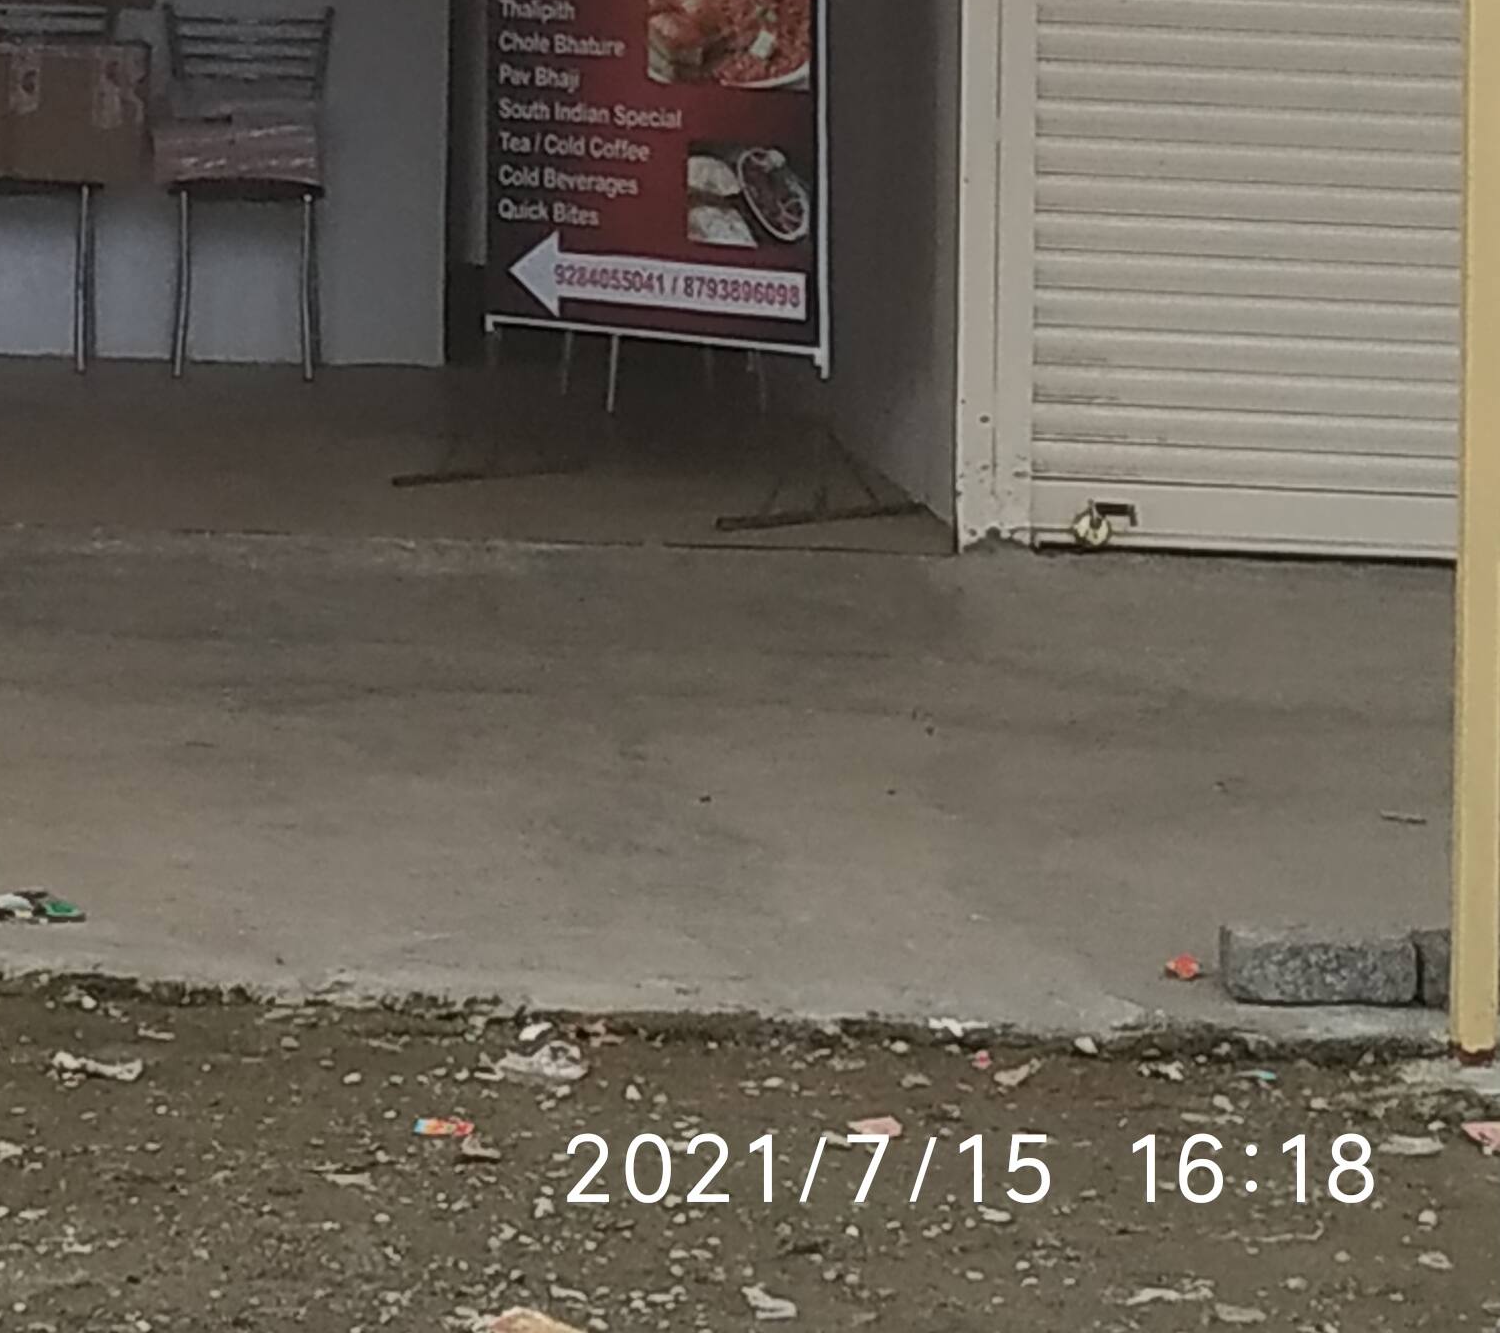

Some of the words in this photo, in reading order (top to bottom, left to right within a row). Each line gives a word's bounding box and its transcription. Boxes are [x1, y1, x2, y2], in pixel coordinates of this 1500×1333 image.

[499, 33, 550, 54] Chole
[554, 36, 626, 58] Bhature
[500, 66, 531, 86] Pav
[535, 68, 580, 93] Bhaji
[499, 99, 550, 121] South
[555, 102, 608, 124] Indian
[615, 105, 682, 130] Special
[500, 132, 531, 152] Tea
[544, 135, 584, 156] Cold
[590, 137, 650, 162] Coffee
[499, 165, 540, 188] Cold
[544, 167, 638, 197] Beverages
[498, 199, 548, 221] Quick
[553, 202, 599, 225] Bites
